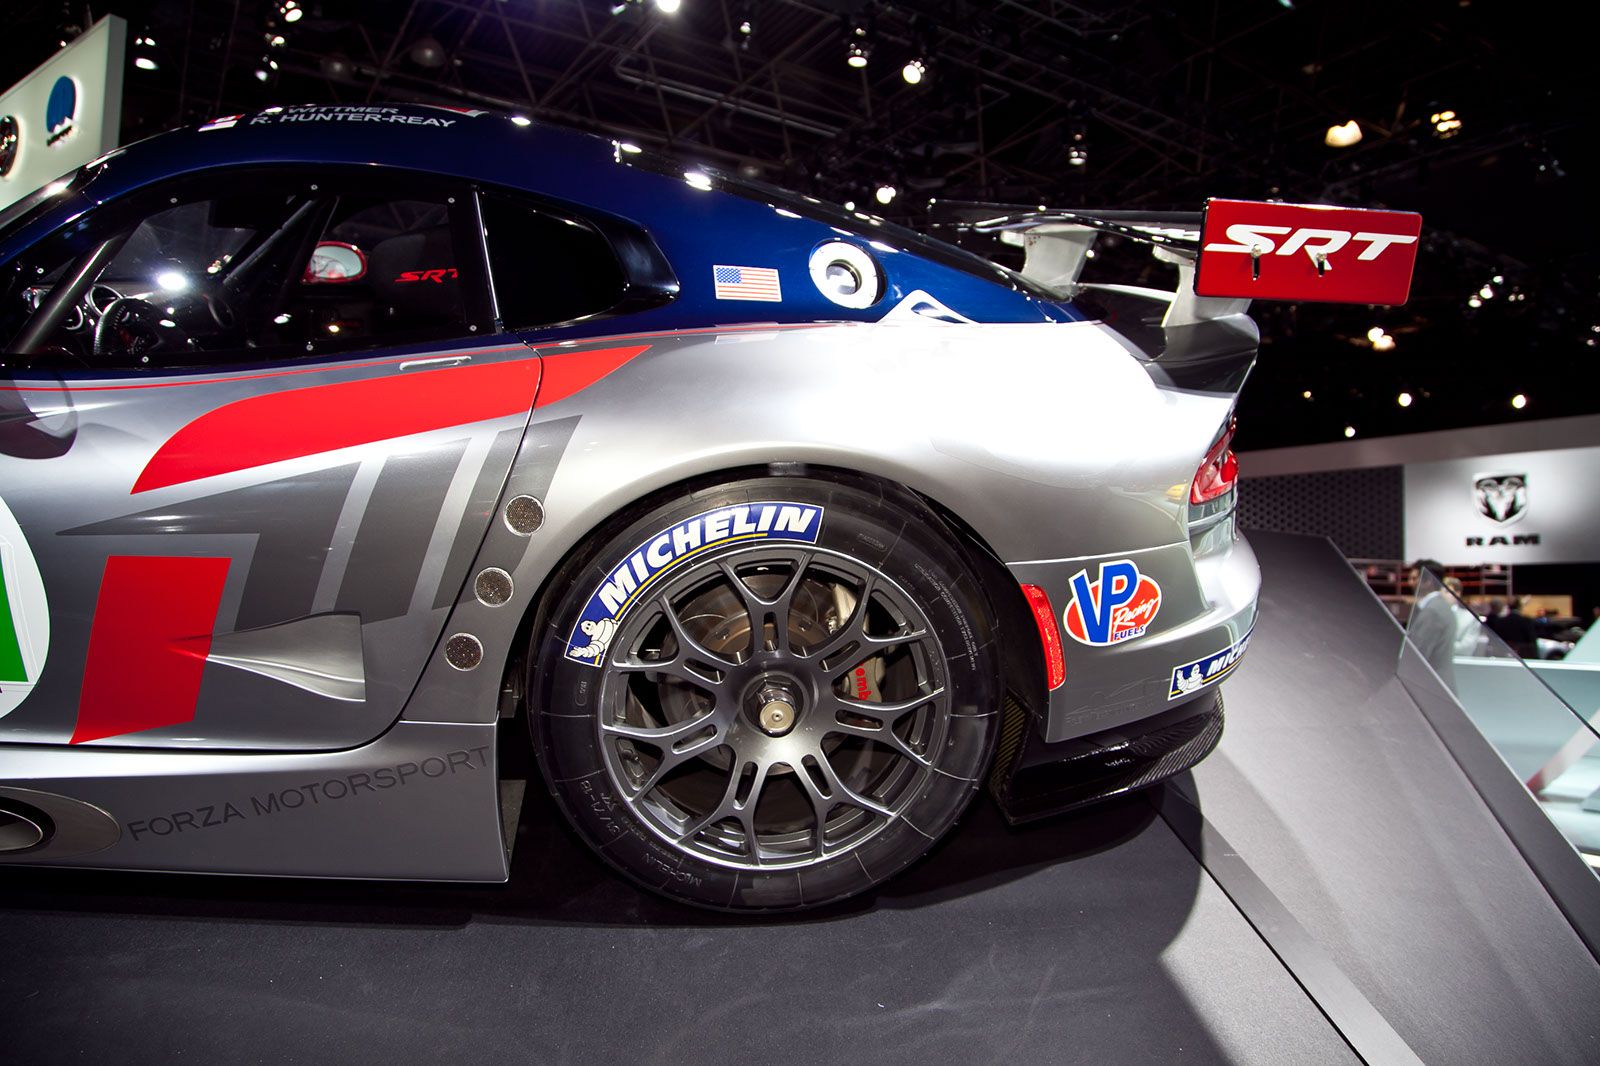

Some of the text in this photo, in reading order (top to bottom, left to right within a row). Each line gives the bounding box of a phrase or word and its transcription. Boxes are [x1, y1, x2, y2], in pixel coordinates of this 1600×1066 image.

[250, 112, 457, 128] R. HUNTER-REAY
[287, 105, 400, 114] WITTMER
[1204, 223, 1418, 271] SRT
[1465, 533, 1541, 547] RAM
[597, 504, 817, 616] MICHELIN
[1072, 562, 1139, 644] VP
[1112, 595, 1160, 632] Racing
[1113, 625, 1146, 641] FUELS
[126, 745, 490, 842] FORZA MOTORSPORT
